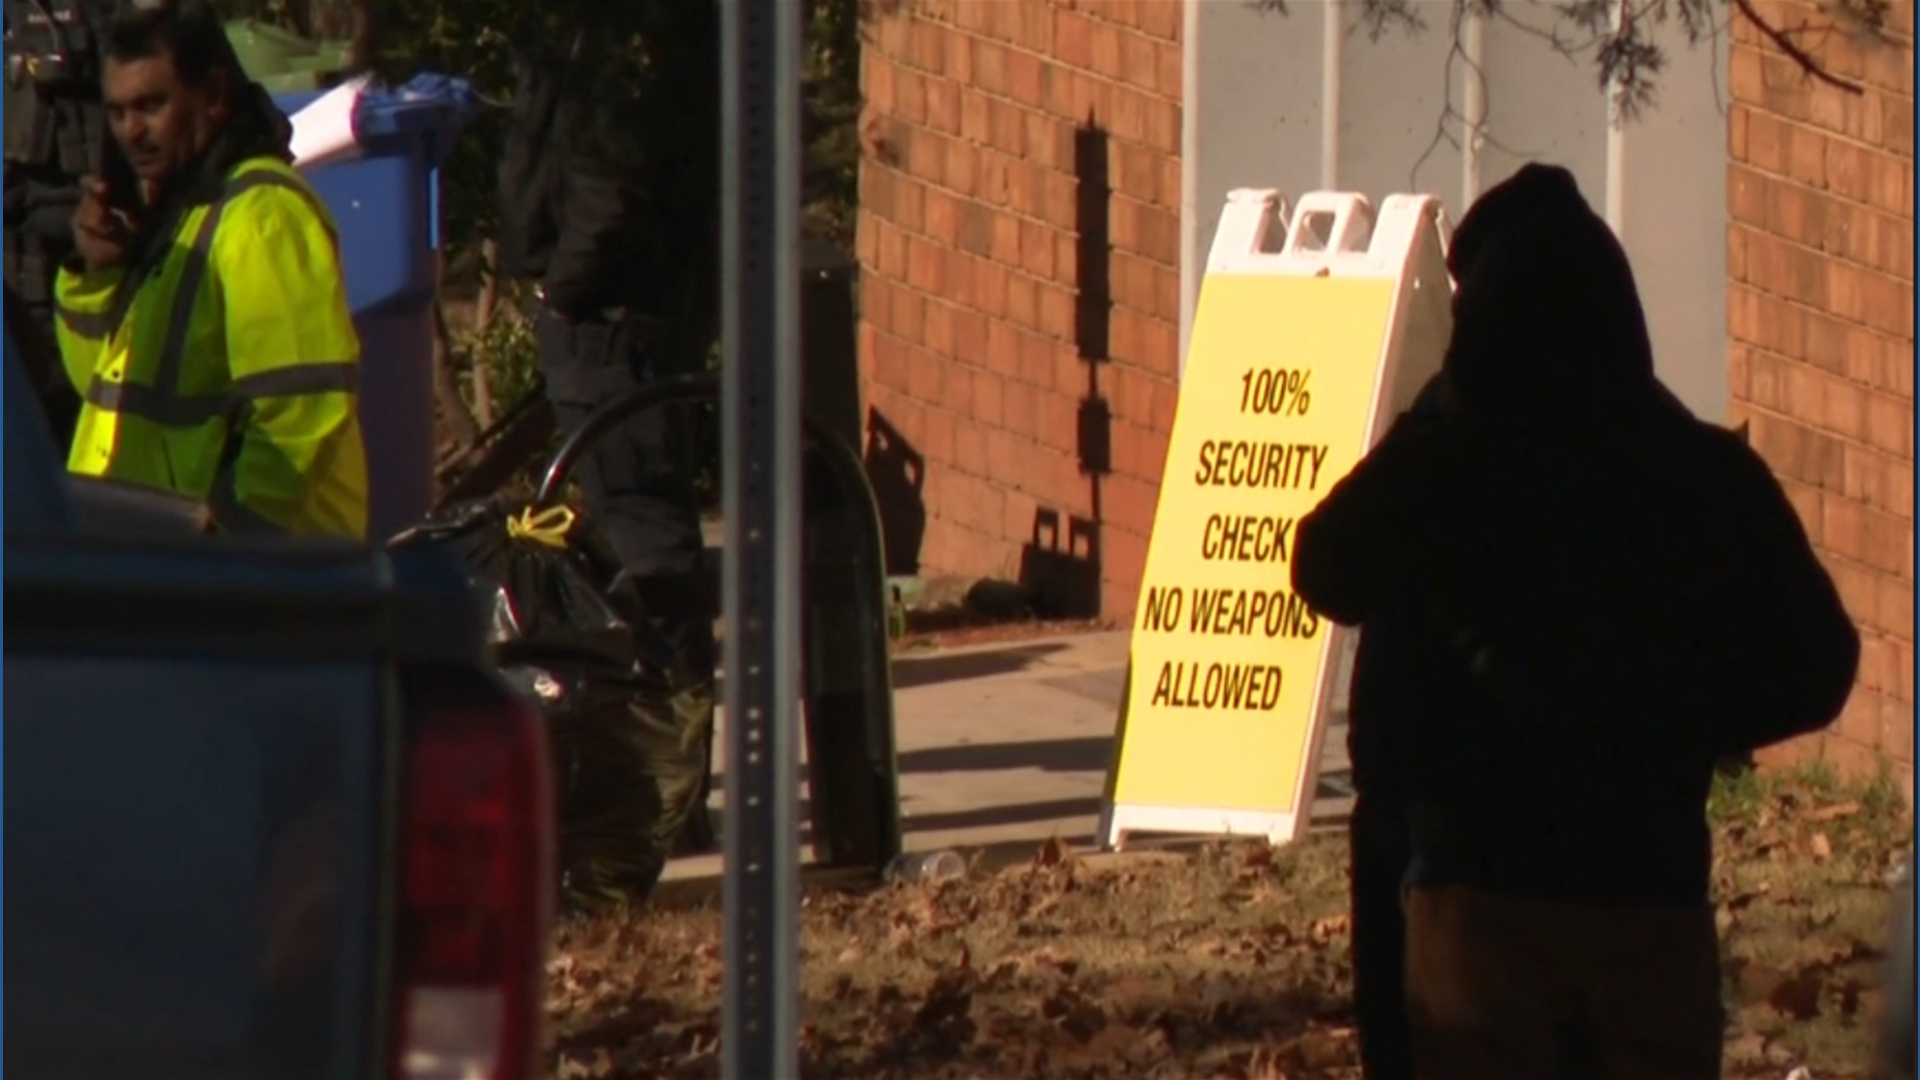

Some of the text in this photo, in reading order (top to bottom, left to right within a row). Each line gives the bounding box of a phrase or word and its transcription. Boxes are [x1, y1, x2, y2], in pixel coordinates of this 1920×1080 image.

[1240, 368, 1311, 416] 100%
[1195, 440, 1328, 490] SECURITY
[1202, 514, 1293, 563] CHECK
[1143, 586, 1319, 639] NO WEAPONS
[1151, 661, 1282, 711] ALLOWED
